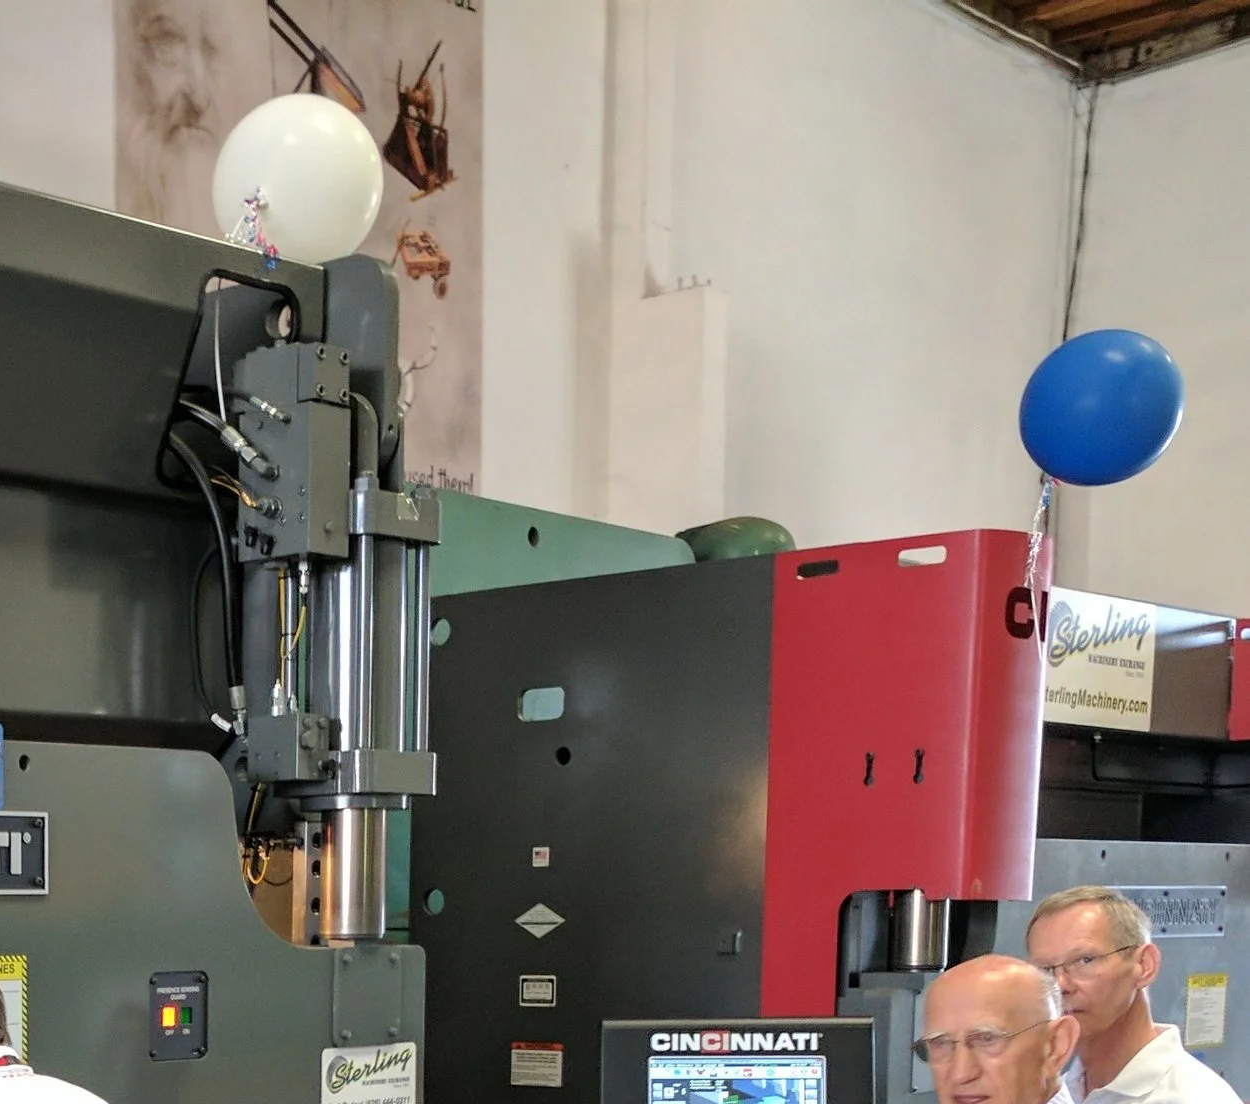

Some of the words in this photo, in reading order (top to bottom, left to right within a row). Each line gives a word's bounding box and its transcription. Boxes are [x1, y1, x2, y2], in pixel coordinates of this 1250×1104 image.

[1050, 604, 1150, 659] Sterling
[1045, 685, 1148, 715] terlingMachinery.com
[650, 1031, 819, 1053] CINCINNATI
[330, 1048, 412, 1090] Sterling
